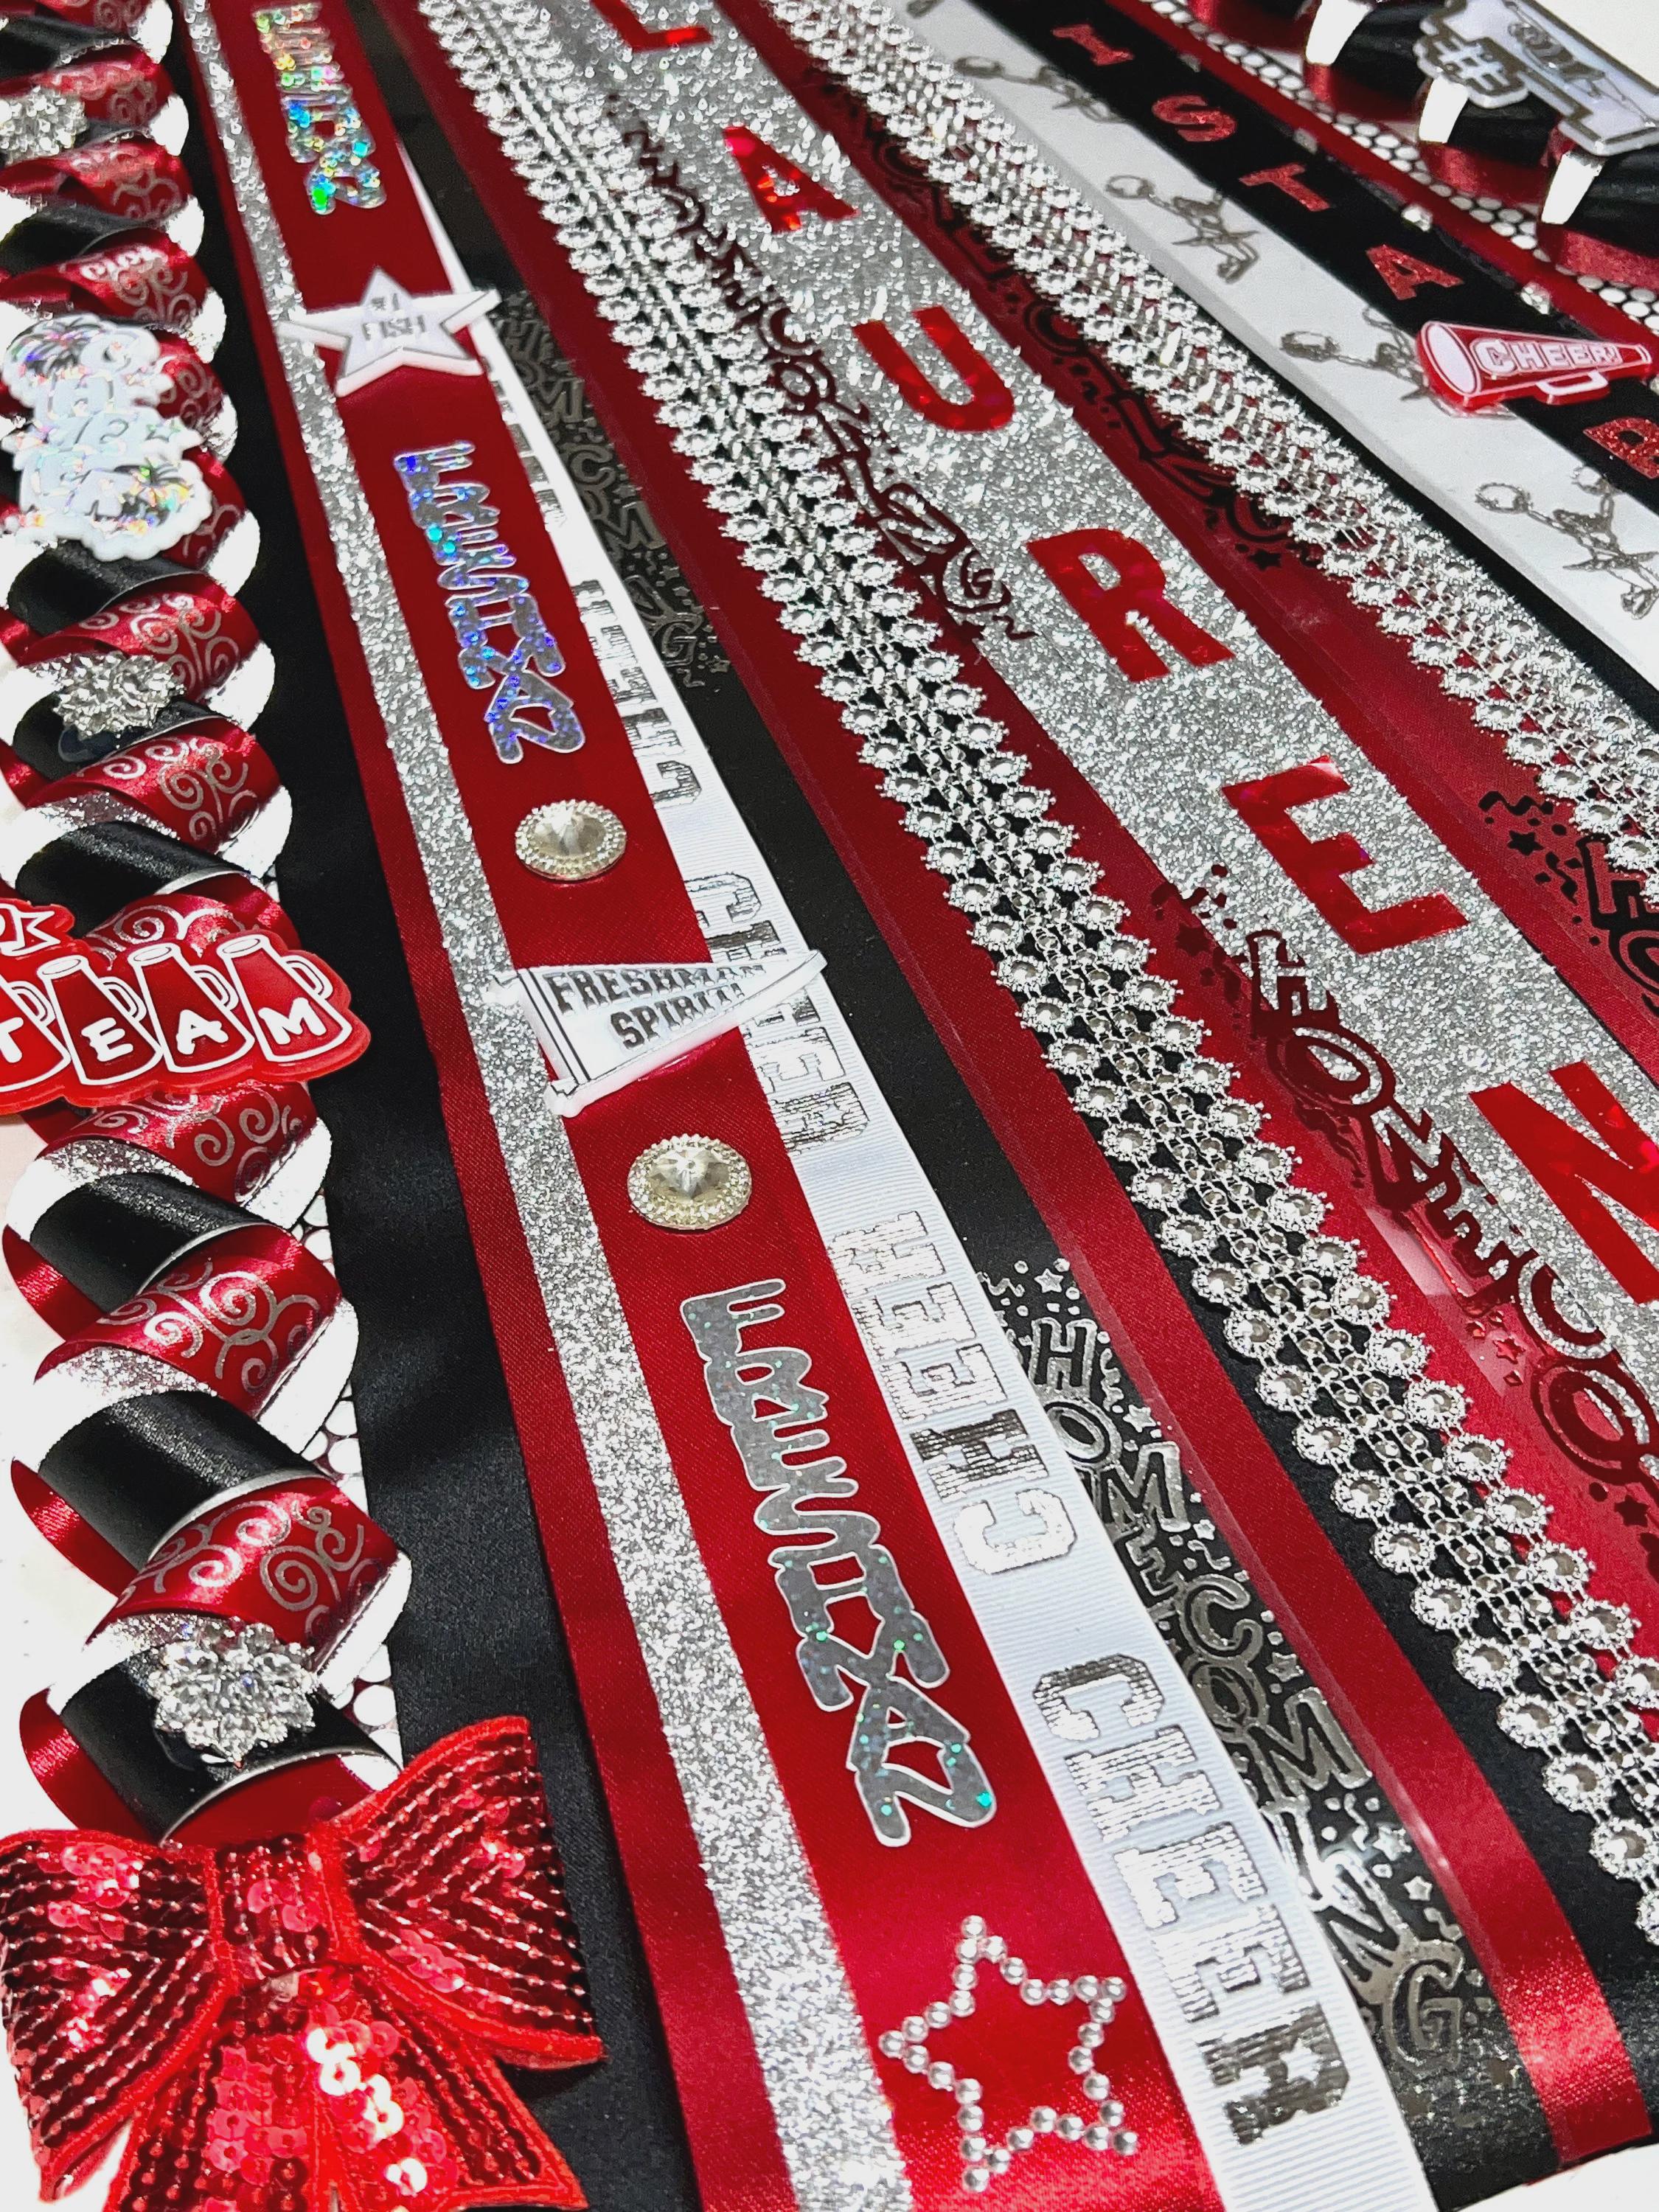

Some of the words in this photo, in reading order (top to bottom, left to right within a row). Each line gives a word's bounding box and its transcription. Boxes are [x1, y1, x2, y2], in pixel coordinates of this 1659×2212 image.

[1472, 339, 1618, 375] CHEER!
[593, 0, 1659, 1304] LAUREN
[541, 964, 768, 1017] FRESHMAN
[610, 981, 746, 1051] SPIRIT!
[0, 997, 328, 1063] TEAM
[827, 1210, 1079, 1575] CHEER
[1032, 1652, 1350, 2146] CHEER
